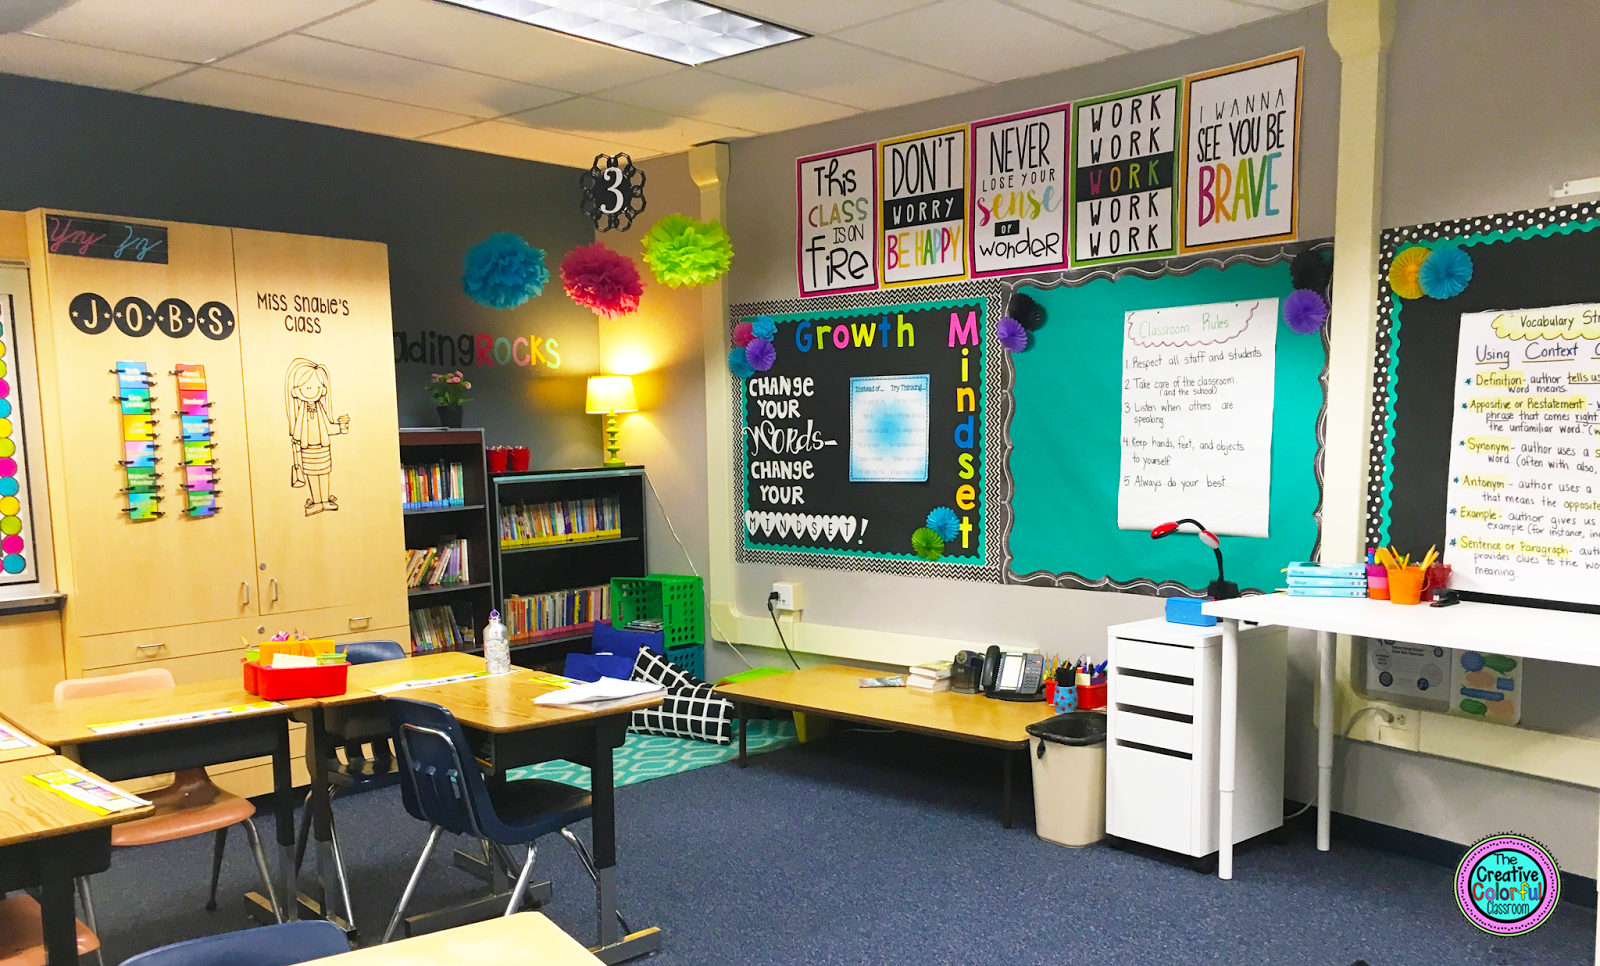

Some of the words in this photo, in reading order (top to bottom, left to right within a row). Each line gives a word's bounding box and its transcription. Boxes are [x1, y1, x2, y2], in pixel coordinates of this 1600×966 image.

[1091, 94, 1162, 133] WORK
[1199, 105, 1204, 124] I
[1215, 88, 1285, 121] WANNA
[1090, 126, 1160, 164] WORK
[1197, 123, 1223, 163] SEE
[1228, 115, 1262, 157] YOU
[1266, 110, 1287, 152] BE
[990, 122, 1051, 176] NEVER
[892, 136, 956, 198] DON'T
[1089, 159, 1160, 196] WORK
[600, 166, 624, 214] 3
[982, 175, 1014, 192] LOSE
[1022, 168, 1055, 187] YOUR
[1198, 151, 1283, 228] BRAVE
[808, 197, 869, 228] CLASS
[892, 197, 955, 226] WORRY
[976, 185, 1062, 227] sense
[1090, 192, 1159, 227] WORK
[832, 227, 846, 245] IS
[847, 223, 865, 242] ON
[1000, 223, 1013, 235] OF
[1089, 223, 1159, 257] WORK
[887, 232, 911, 270] BE
[914, 225, 961, 267] HAPPY
[82, 298, 225, 337] JOBS
[1139, 320, 1190, 339] Classroom
[1202, 312, 1230, 331] Rules
[1520, 314, 1575, 331] Vocabulary
[1582, 309, 1600, 325] St
[795, 314, 915, 353] Growth
[475, 333, 562, 370] ROCKS
[1132, 354, 1162, 371] Respect
[1168, 355, 1179, 366] all
[1184, 351, 1206, 365] staff
[1209, 351, 1225, 363] and
[1475, 344, 1511, 370] Using
[1525, 341, 1579, 360] Context
[854, 385, 875, 393] Instead
[890, 384, 900, 393] Try
[1133, 377, 1151, 389] Take
[1154, 380, 1170, 389] care
[1173, 375, 1182, 388] of
[1182, 376, 1195, 387] the
[1508, 384, 1530, 393] word
[1530, 372, 1562, 384] author
[1567, 371, 1589, 383] tells
[1159, 388, 1176, 397] (and
[1178, 387, 1189, 396] the
[1193, 385, 1218, 395] school)
[756, 398, 802, 420] YOUR
[1134, 401, 1157, 412] Listen
[1160, 399, 1182, 412] when
[1188, 399, 1212, 411] others
[1221, 402, 1234, 410] are
[1469, 399, 1511, 414] Appositive
[1514, 400, 1524, 409] or
[1527, 397, 1585, 409] Restatement
[948, 310, 979, 549] Mindset
[1486, 411, 1515, 424] phrase
[1518, 410, 1540, 420] that
[1544, 412, 1570, 421] comes
[1575, 411, 1598, 427] right
[1489, 421, 1504, 432] the
[1509, 421, 1554, 434] unfamiliar
[1131, 436, 1147, 449] Keep
[1151, 436, 1175, 449] hands,
[1177, 435, 1195, 451] feet,
[1199, 439, 1214, 450] and
[1216, 439, 1245, 456] objects
[1521, 441, 1552, 454] author
[1557, 446, 1576, 457] uses
[1583, 448, 1590, 457] a
[1132, 451, 1140, 463] to
[1516, 454, 1543, 468] (often
[1548, 459, 1570, 470] with
[1576, 461, 1598, 475] also,
[758, 484, 806, 505] YOUR
[1134, 475, 1162, 492] Always
[1167, 476, 1177, 487] do
[1181, 479, 1200, 492] your
[1462, 475, 1505, 492] Antonym
[1518, 478, 1554, 491] author
[1558, 483, 1581, 493] uses
[1585, 485, 1593, 494] a
[1481, 491, 1501, 502] that
[1505, 495, 1535, 505] means
[1541, 495, 1557, 508] the
[1487, 521, 1525, 536] example
[1527, 522, 1545, 535] (for
[1548, 526, 1586, 539] instance,
[1508, 511, 1544, 522] author
[1550, 516, 1577, 530] gives
[1583, 517, 1596, 526] us
[1460, 535, 1502, 550] Sentence
[1504, 542, 1515, 551] or
[1473, 551, 1510, 564] provides
[1516, 553, 1539, 564] clues
[1546, 555, 1556, 566] to
[1559, 557, 1579, 567] the
